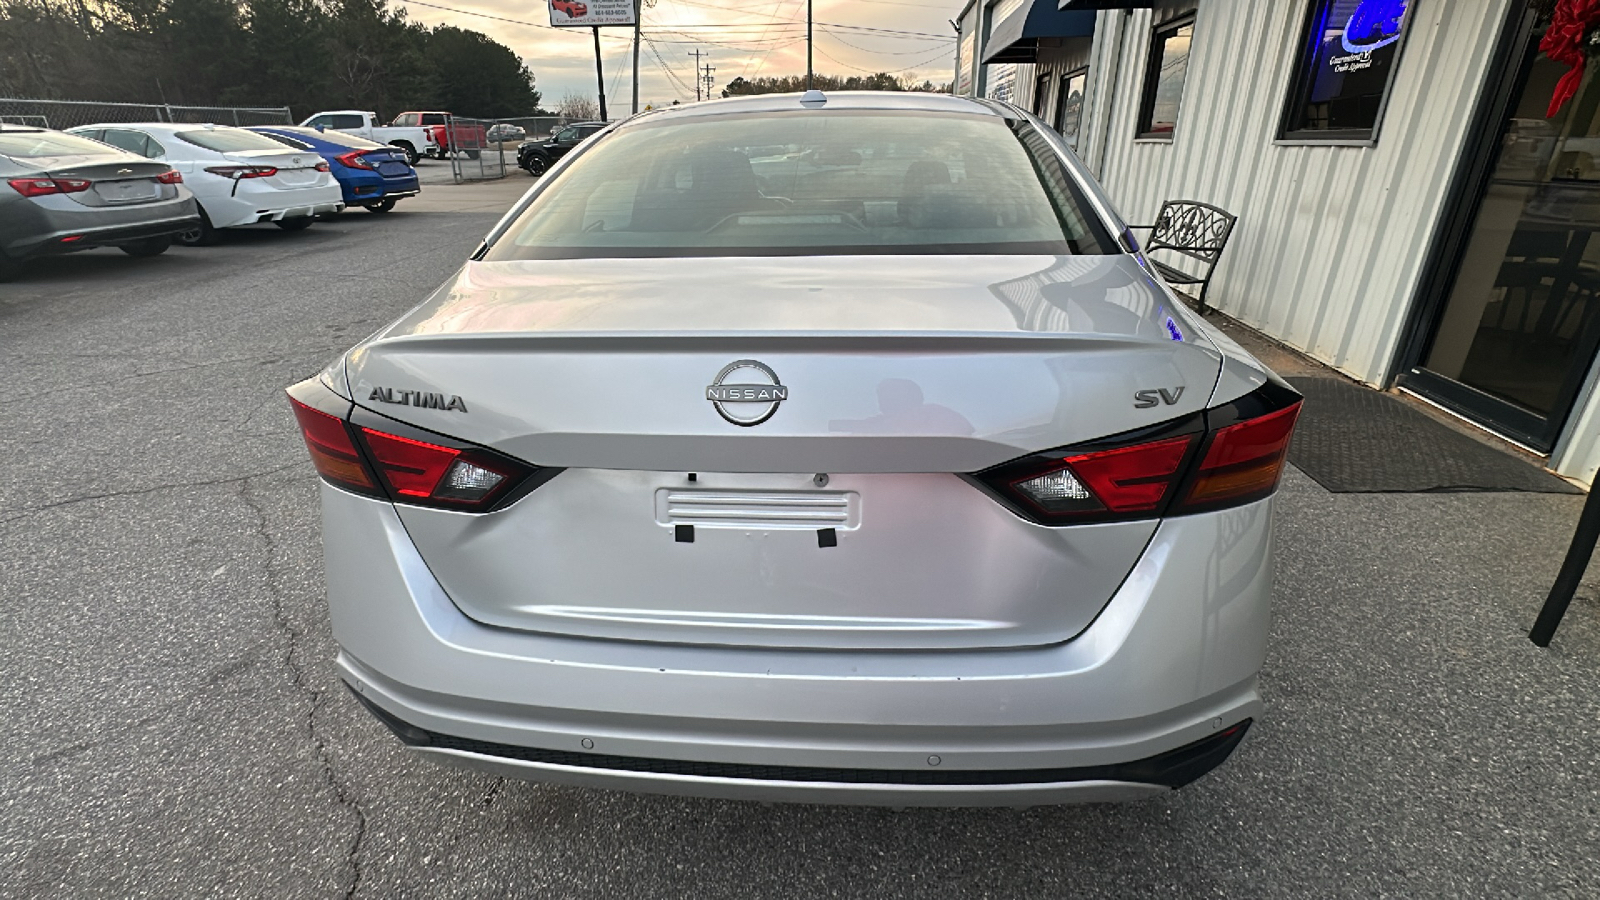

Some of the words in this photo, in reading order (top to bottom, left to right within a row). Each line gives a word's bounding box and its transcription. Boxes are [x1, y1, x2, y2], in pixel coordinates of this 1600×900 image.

[1329, 53, 1363, 65] Guaranteed
[1334, 63, 1348, 72] Credit
[1348, 60, 1372, 73] Approval
[368, 386, 468, 413] ALTIMA
[708, 388, 786, 399] NISSAN
[1134, 386, 1185, 409] SV
